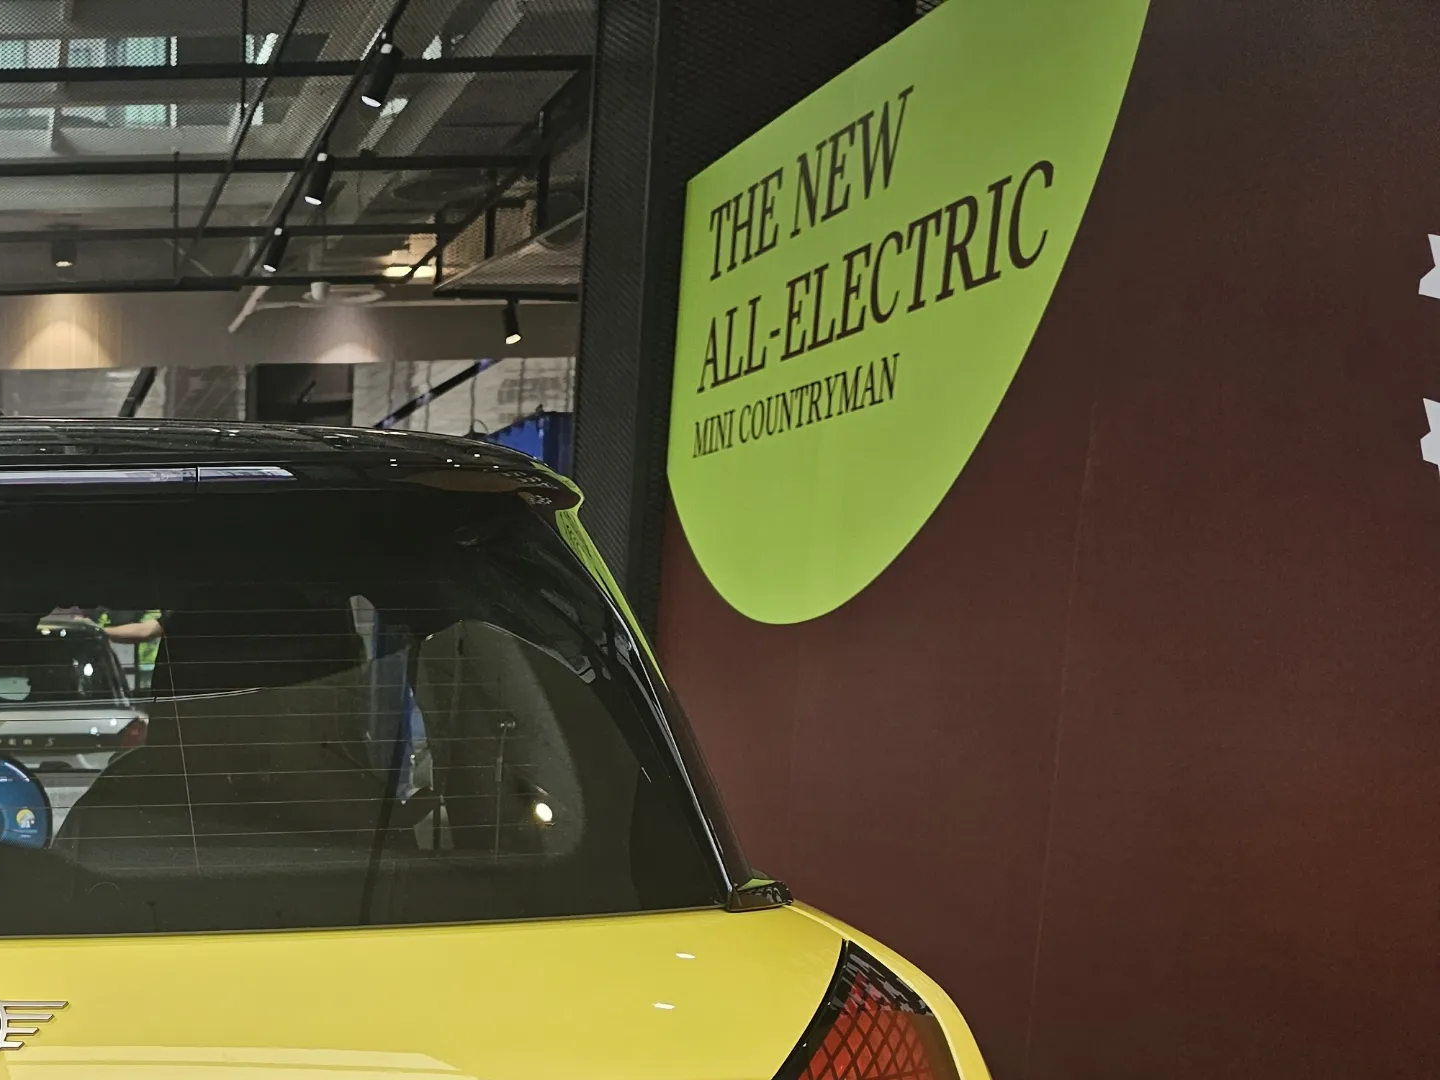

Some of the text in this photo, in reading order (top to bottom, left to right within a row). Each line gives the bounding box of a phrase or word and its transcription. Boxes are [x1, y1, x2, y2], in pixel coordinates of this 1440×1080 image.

[697, 160, 1054, 393] ALL-ELECTRIC
[709, 85, 914, 281] THE NEW
[692, 353, 900, 458] MINI COUNTRYMAN
